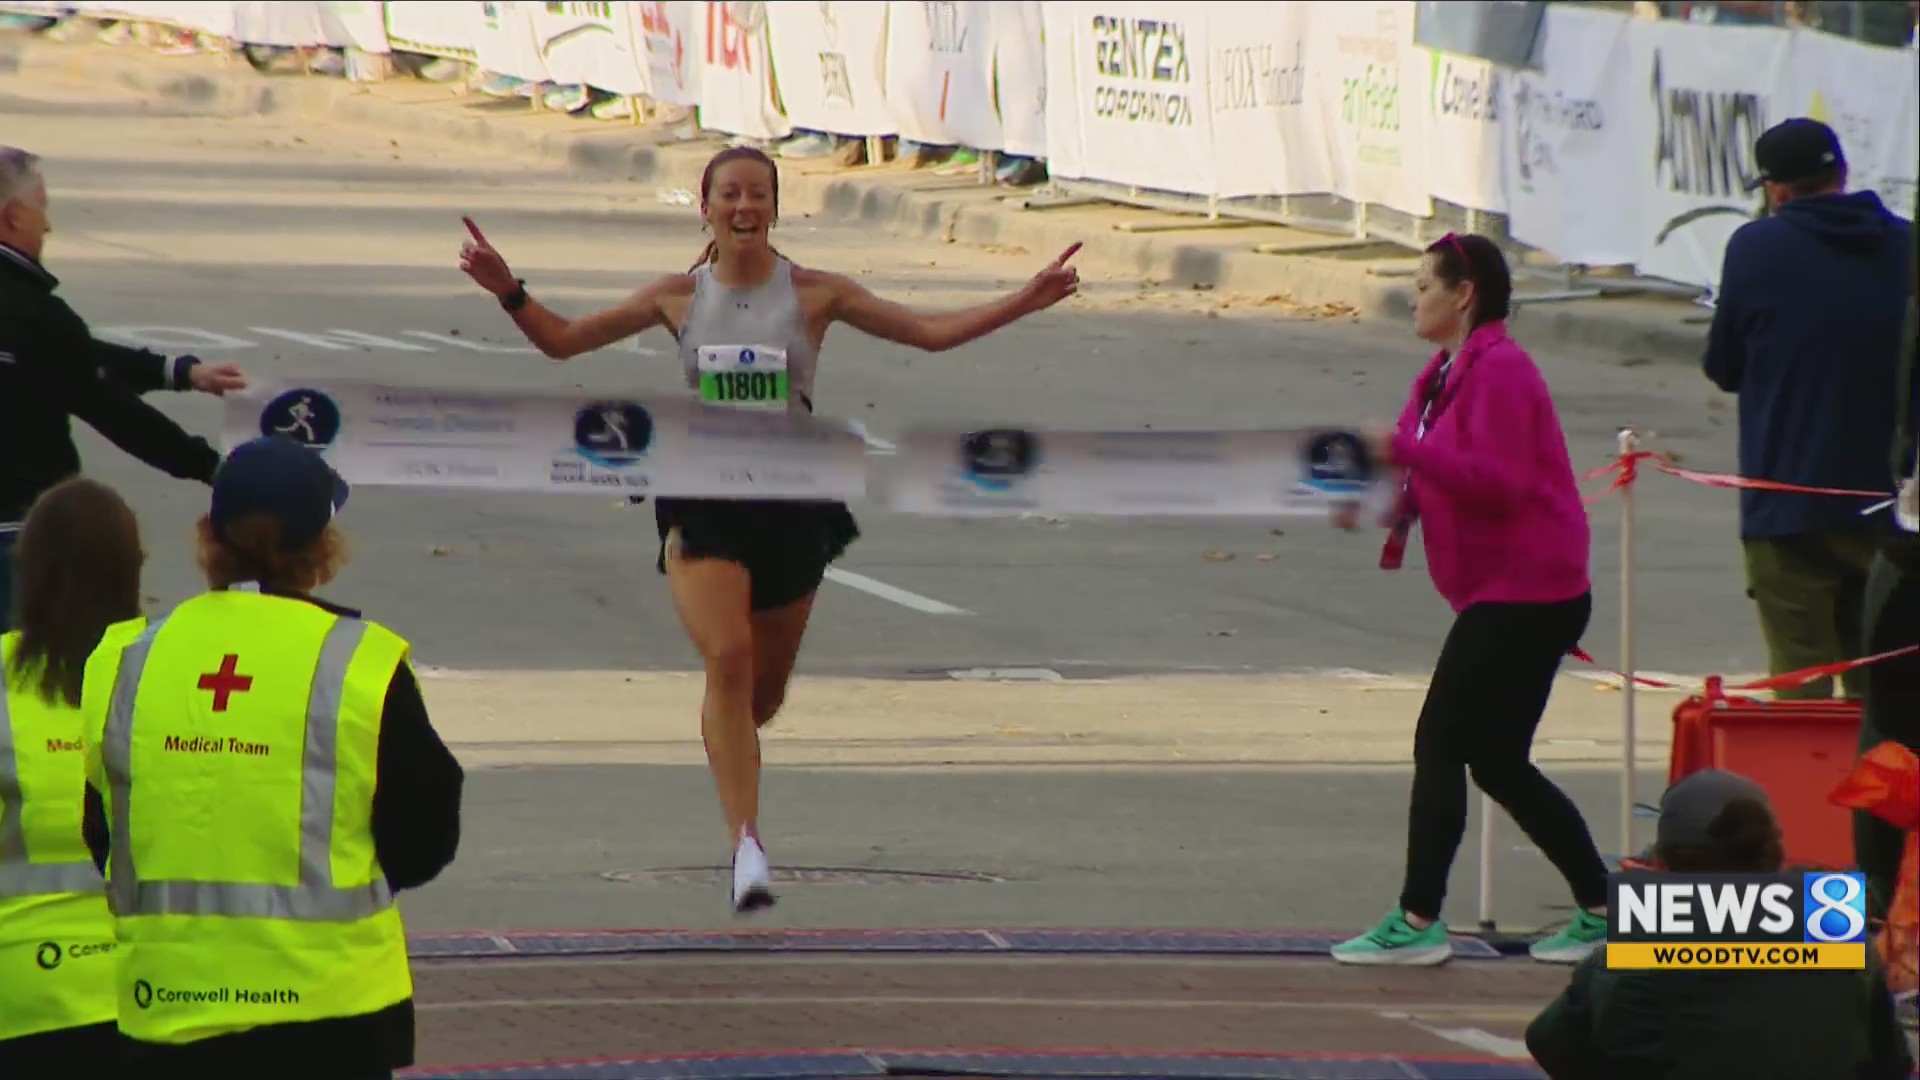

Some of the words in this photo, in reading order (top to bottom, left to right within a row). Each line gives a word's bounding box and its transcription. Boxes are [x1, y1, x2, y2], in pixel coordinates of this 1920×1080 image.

[1093, 14, 1190, 83] GENTEX
[715, 371, 777, 401] 11801
[164, 735, 224, 753] Medical
[228, 736, 270, 756] Team
[156, 987, 229, 1004] Corewell
[234, 988, 300, 1004] Health
